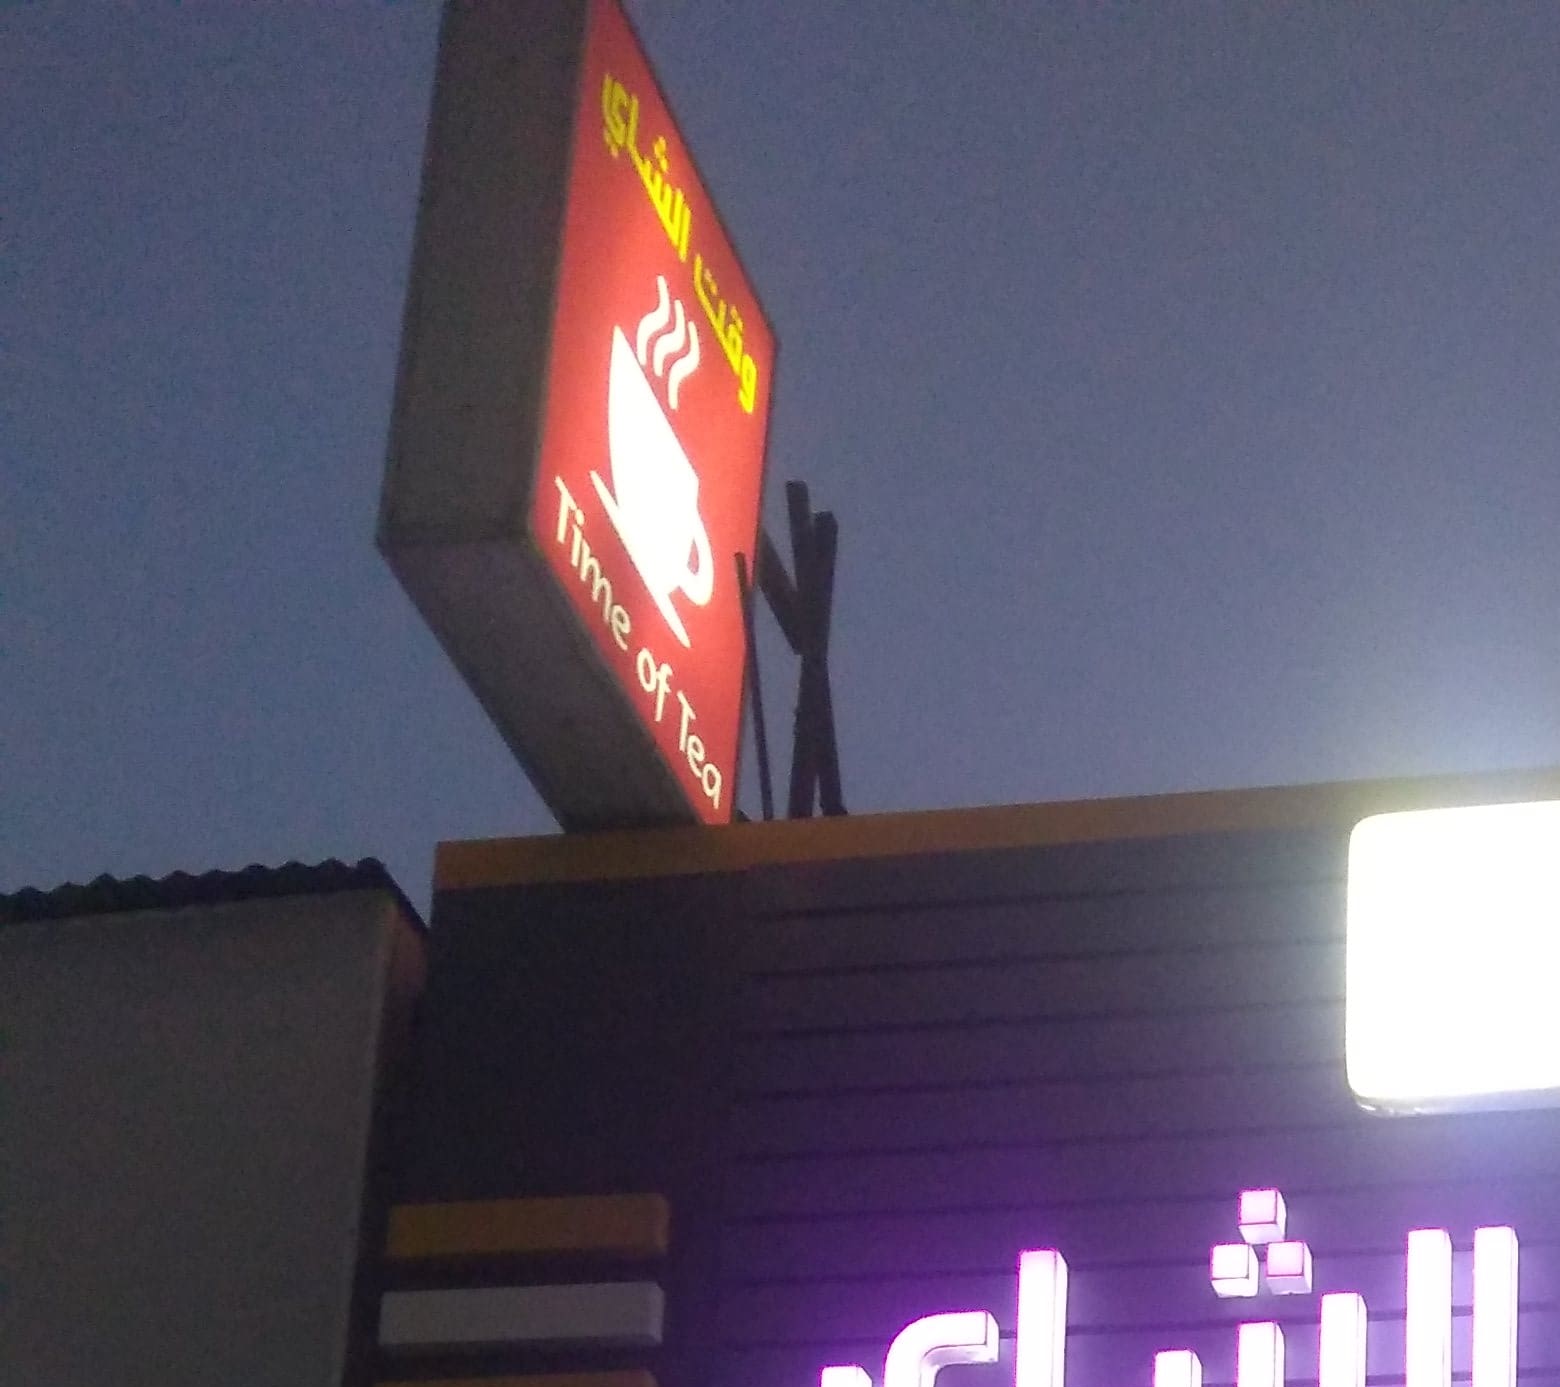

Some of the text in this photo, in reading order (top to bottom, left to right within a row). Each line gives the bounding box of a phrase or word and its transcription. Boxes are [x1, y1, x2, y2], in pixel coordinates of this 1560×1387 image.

[554, 475, 723, 810] Time of Tea
